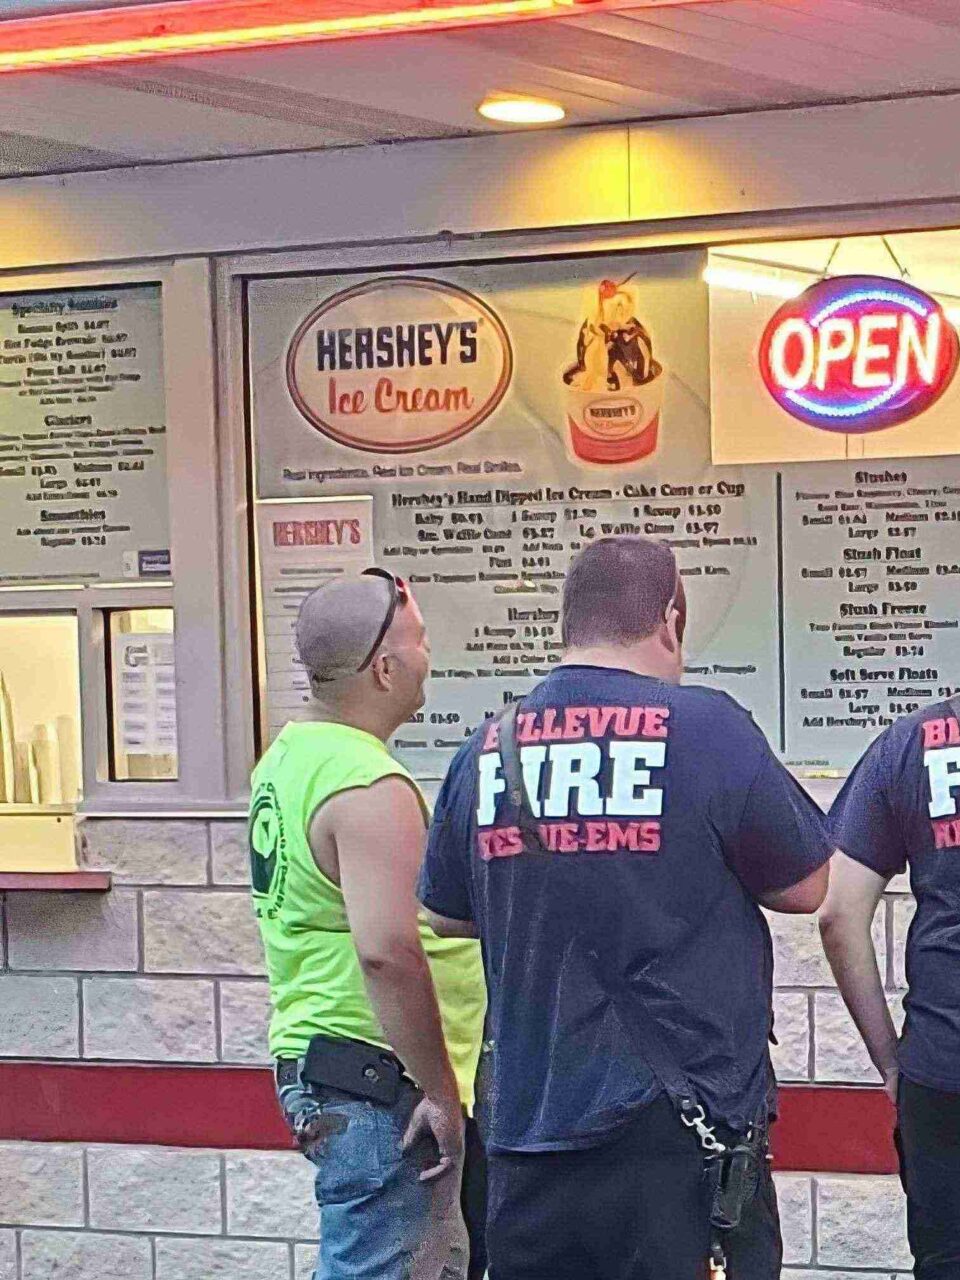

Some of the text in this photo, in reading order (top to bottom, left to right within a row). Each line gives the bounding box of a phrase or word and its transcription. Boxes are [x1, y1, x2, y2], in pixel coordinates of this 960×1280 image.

[317, 321, 477, 371] HERSHEY'S
[771, 313, 940, 390] OPEN
[329, 376, 474, 414] Ice Cream
[855, 470, 907, 484] Slushes
[392, 481, 745, 507] Hershey's Hand Dipped Ice Cream Cake Cone or Cup
[273, 519, 360, 546] HERSHEY'S
[444, 529, 481, 540] Waffle
[483, 528, 512, 539] Cone
[601, 524, 640, 534] Waffle
[644, 523, 674, 533] Cone
[849, 527, 878, 540] Large
[843, 547, 921, 560] Slush Float
[848, 582, 879, 594] Large
[840, 602, 926, 616] Slush Freeze
[830, 667, 938, 680] Soft Serve Floats
[849, 702, 880, 714] Large
[803, 717, 823, 727] Add
